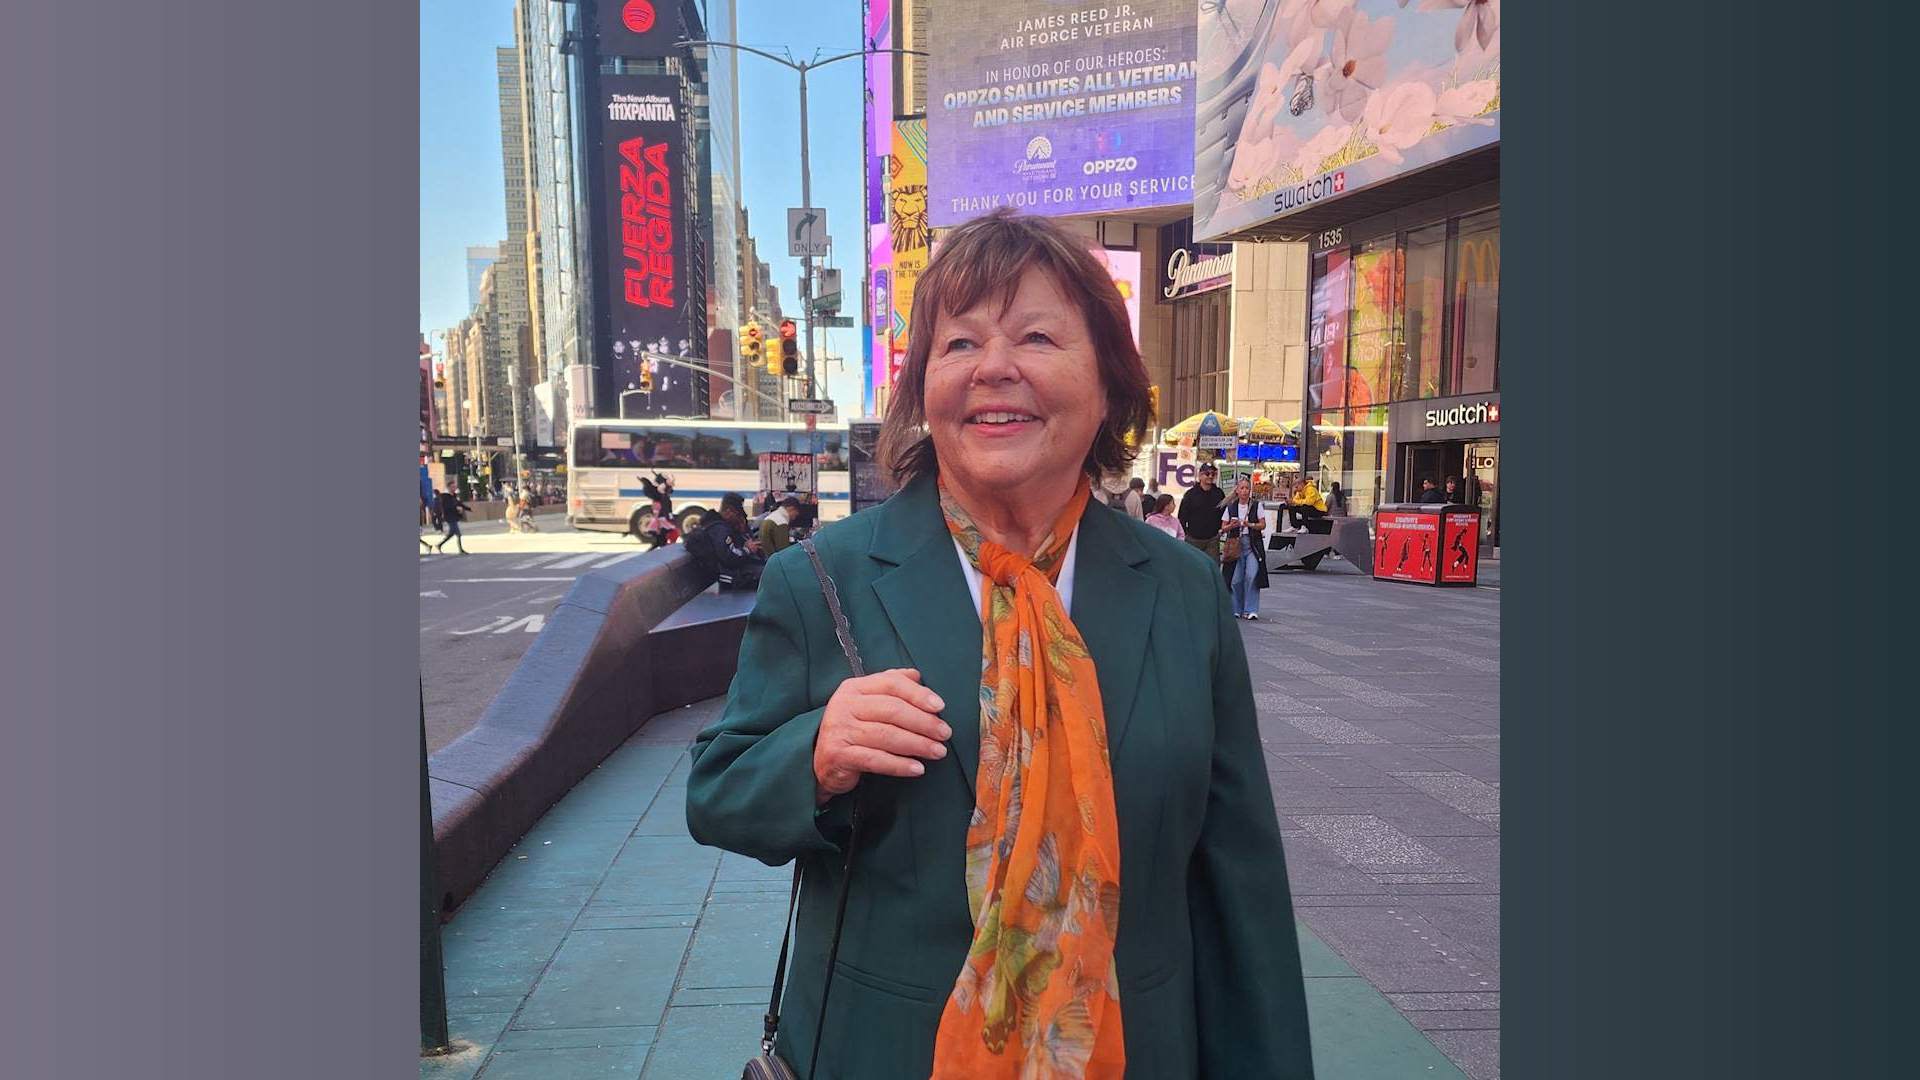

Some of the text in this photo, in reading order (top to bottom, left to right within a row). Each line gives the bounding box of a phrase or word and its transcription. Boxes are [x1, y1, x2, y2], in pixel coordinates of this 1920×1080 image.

[1000, 17, 1153, 50] AIR FORCE VETERAN
[1016, 4, 1136, 33] JAMES REED JR.
[985, 47, 1166, 84] IN HONOR OF OUR HEROES:
[612, 94, 670, 103] The New Album
[943, 87, 1001, 110] OPPZO
[1003, 76, 1079, 101] SALUTES
[1083, 71, 1115, 91] ALL
[972, 86, 1182, 128] AND SERVICE MEMBERS
[1083, 157, 1137, 175] OPPZO
[952, 195, 1000, 213] THANK
[1006, 192, 1037, 208] YOU
[1043, 187, 1073, 204] FOR
[1080, 182, 1123, 200] YOUR
[1273, 172, 1333, 213] swatch
[618, 136, 649, 308] FUERZA
[644, 142, 673, 308] REGIDA
[793, 243, 822, 253] ONLY
[1318, 228, 1343, 249] 1535
[896, 270, 906, 279] THE
[899, 260, 921, 269] NOW IS
[1425, 402, 1487, 427] swatch
